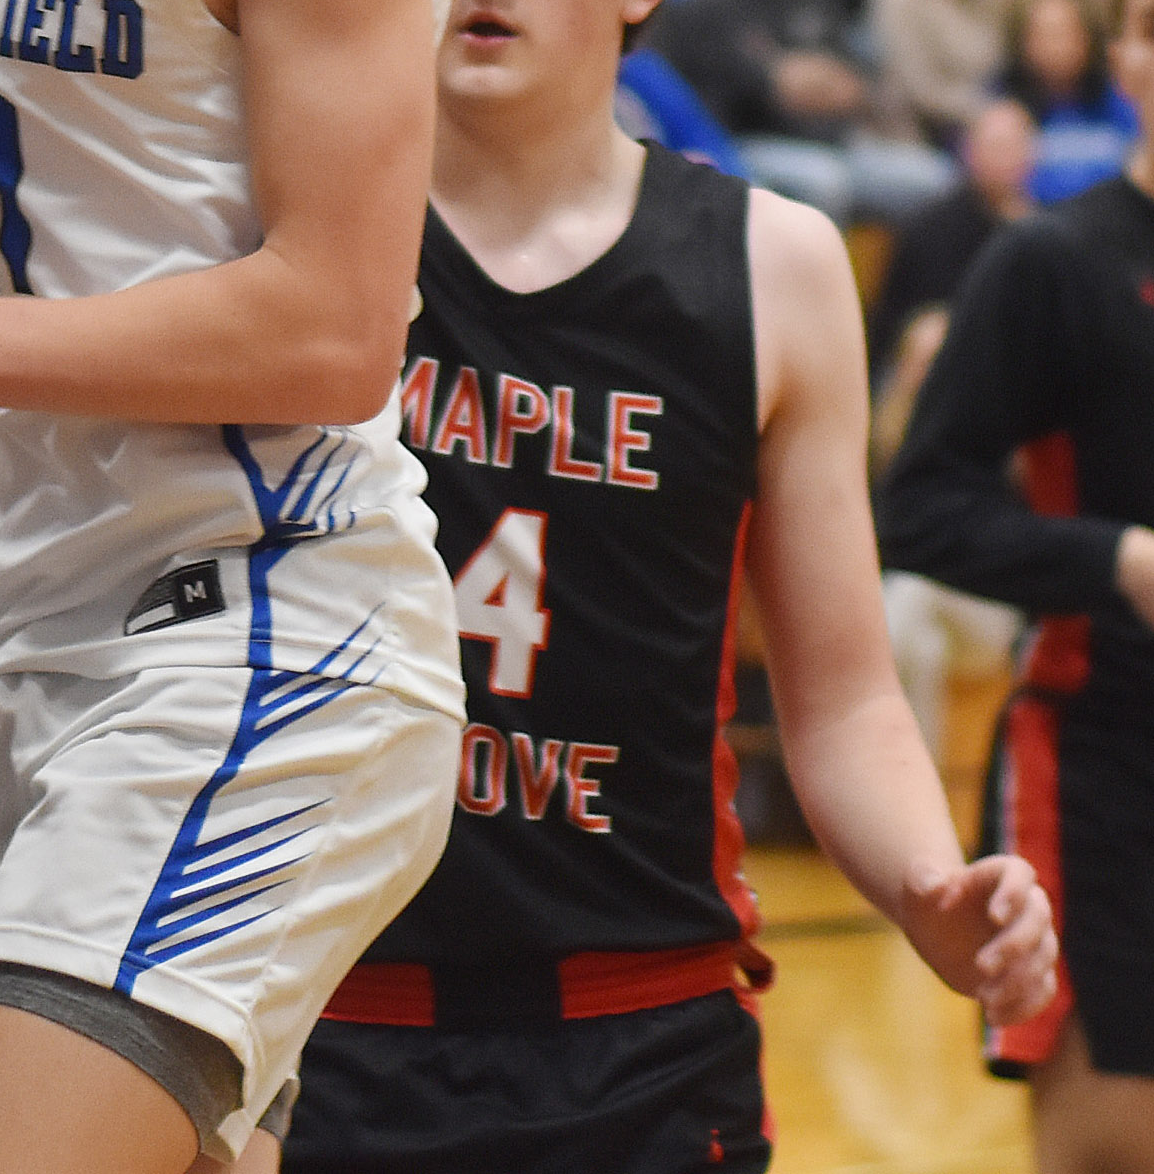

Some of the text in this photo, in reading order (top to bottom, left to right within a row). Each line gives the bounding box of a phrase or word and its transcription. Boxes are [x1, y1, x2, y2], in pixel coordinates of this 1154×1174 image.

[183, 580, 207, 603] M
[454, 506, 552, 699] 4
[457, 723, 619, 833] OVE
